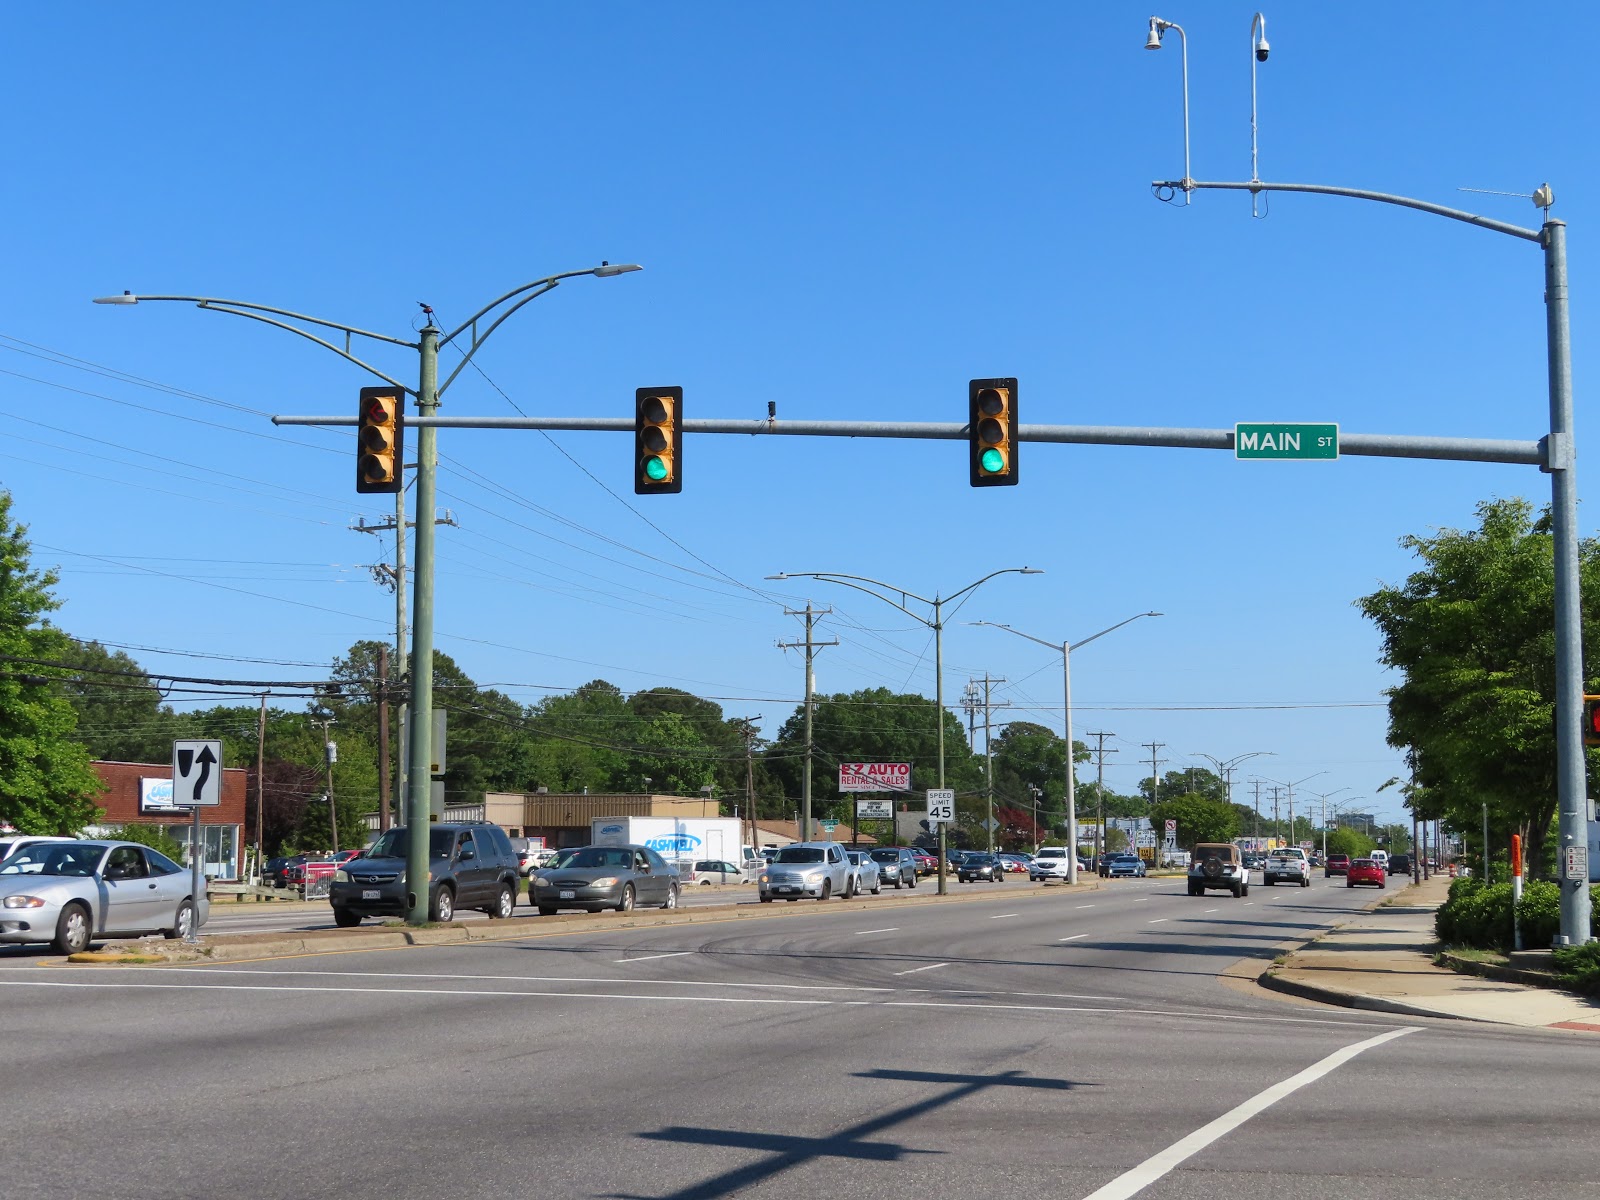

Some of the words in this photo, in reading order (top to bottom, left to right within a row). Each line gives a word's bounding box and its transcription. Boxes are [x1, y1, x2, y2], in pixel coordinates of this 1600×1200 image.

[1240, 432, 1300, 451] MAIN
[1317, 437, 1333, 447] ST
[868, 764, 909, 775] AUTO
[841, 776, 870, 785] RENTAL
[881, 776, 905, 785] SALES
[929, 806, 952, 819] 45
[645, 839, 694, 852] CASHWELL
